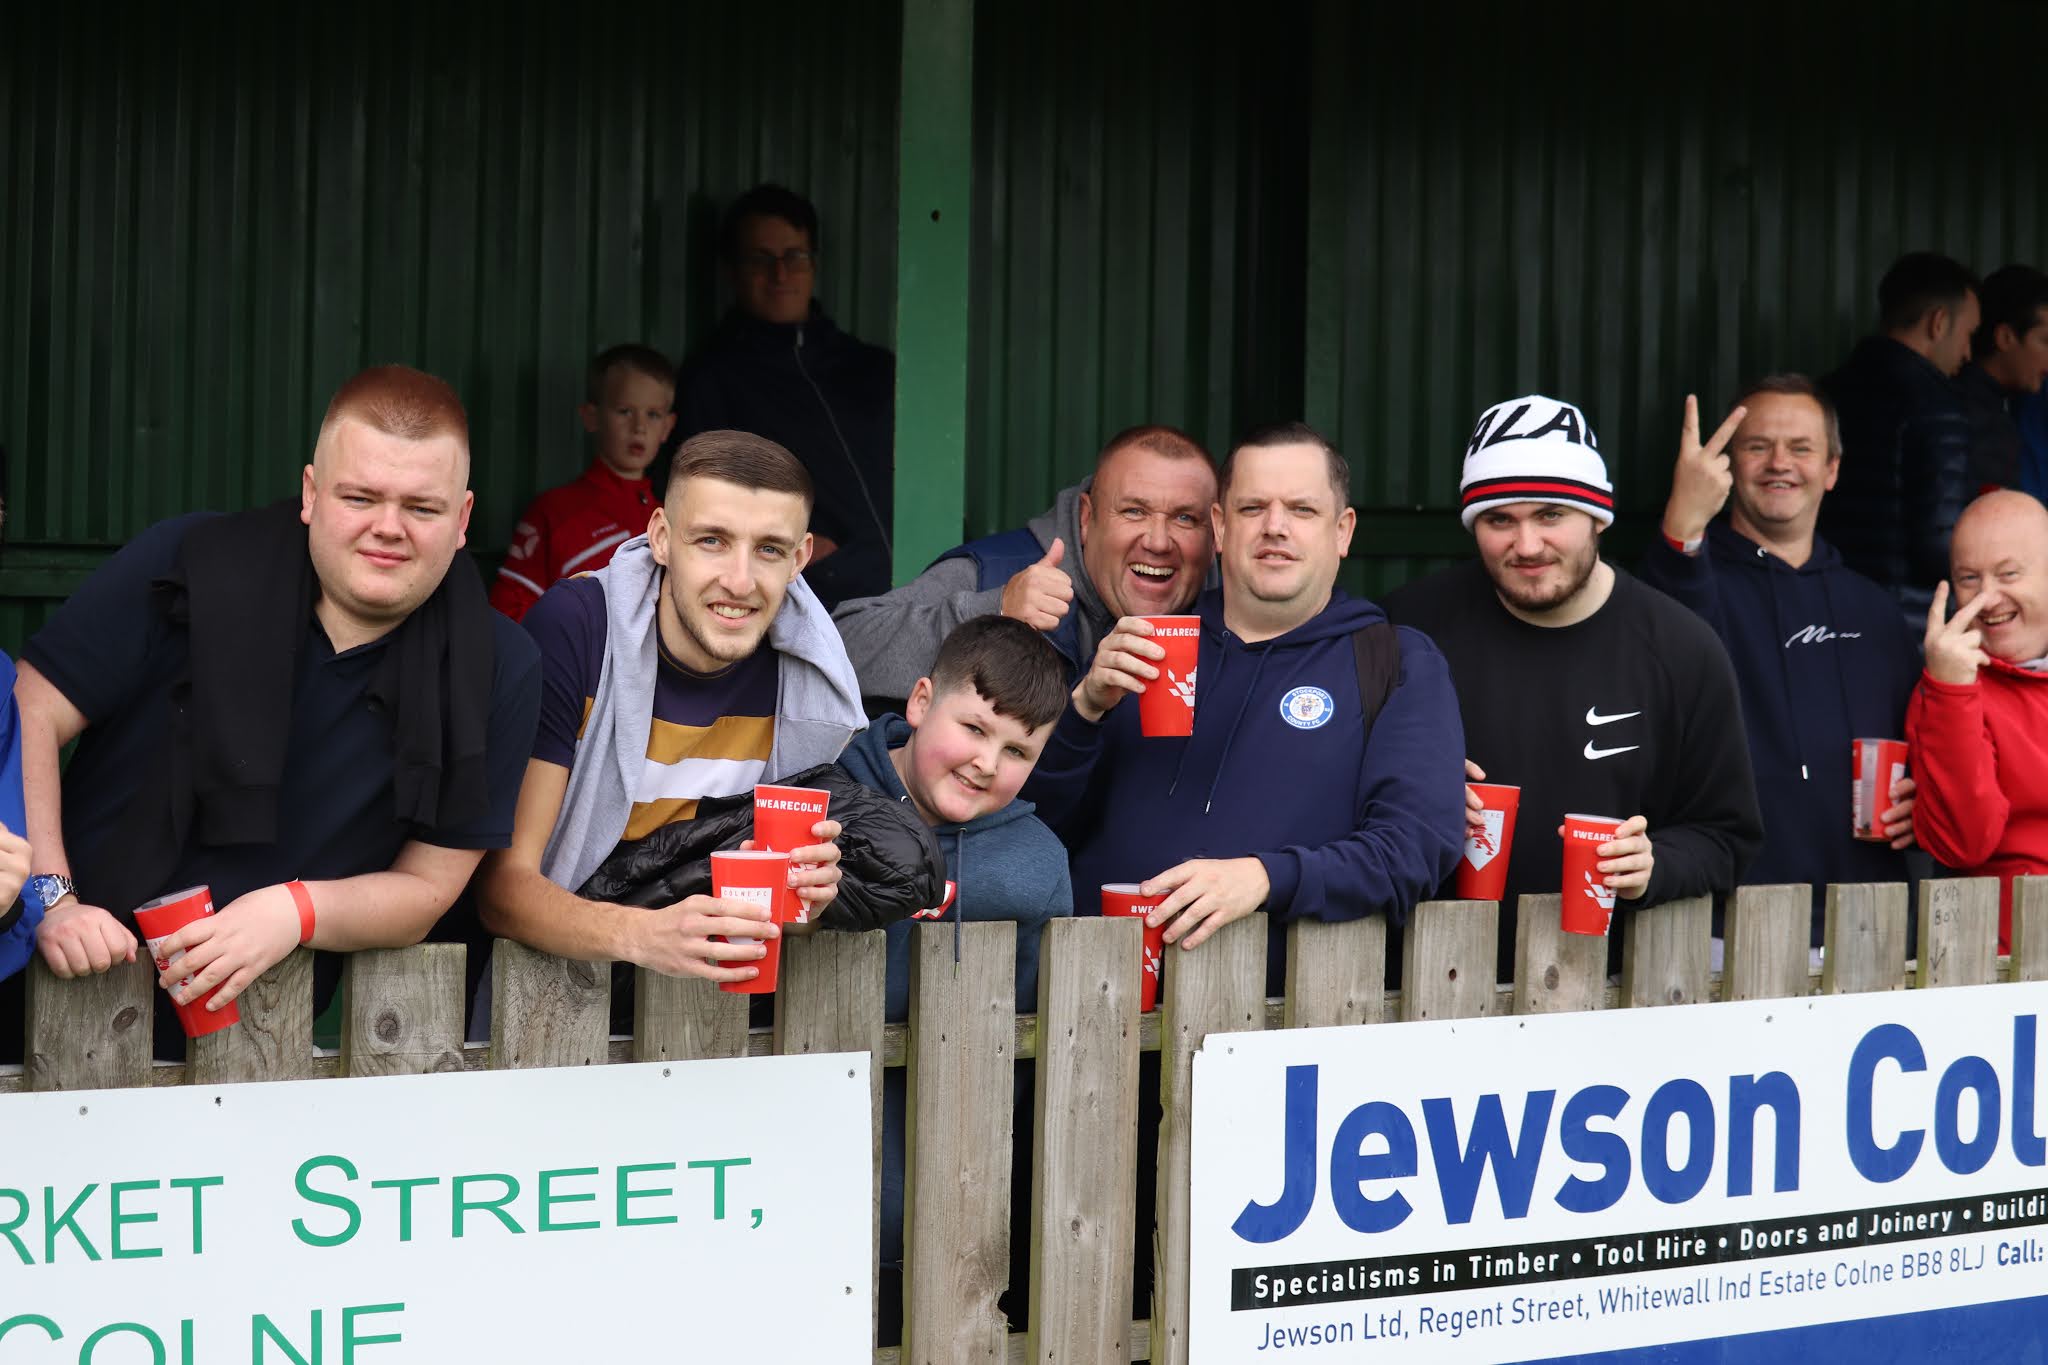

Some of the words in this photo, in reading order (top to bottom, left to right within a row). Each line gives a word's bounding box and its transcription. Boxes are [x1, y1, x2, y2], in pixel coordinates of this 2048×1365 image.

[1230, 1064, 1800, 1243] Jewson
[1847, 1014, 2047, 1183] Col
[0, 1175, 224, 1265] RKET
[291, 1154, 763, 1247] STREET,
[1254, 1266, 1420, 1302] Specialisms
[1433, 1260, 1456, 1282] in
[1469, 1252, 1559, 1278] Timber
[1594, 1240, 1644, 1266] Tool
[1656, 1235, 1706, 1260] Hire
[1740, 1228, 1807, 1251] Doors
[1818, 1216, 1857, 1242] and
[1868, 1211, 1952, 1236] Joinery
[1257, 1322, 1353, 1350] Jewson
[1364, 1309, 1409, 1340] Ltd,
[1419, 1301, 1502, 1338] Regent
[1512, 1293, 1590, 1324] Street,
[1598, 1277, 1710, 1315] Whitewall
[1719, 1273, 1750, 1301] Ind
[1760, 1268, 1826, 1296] Estate
[1834, 1259, 1894, 1287] Colne
[1902, 1250, 1942, 1279] BB8
[1950, 1245, 1984, 1272] 8LJ
[1997, 1239, 2043, 1266] Call:
